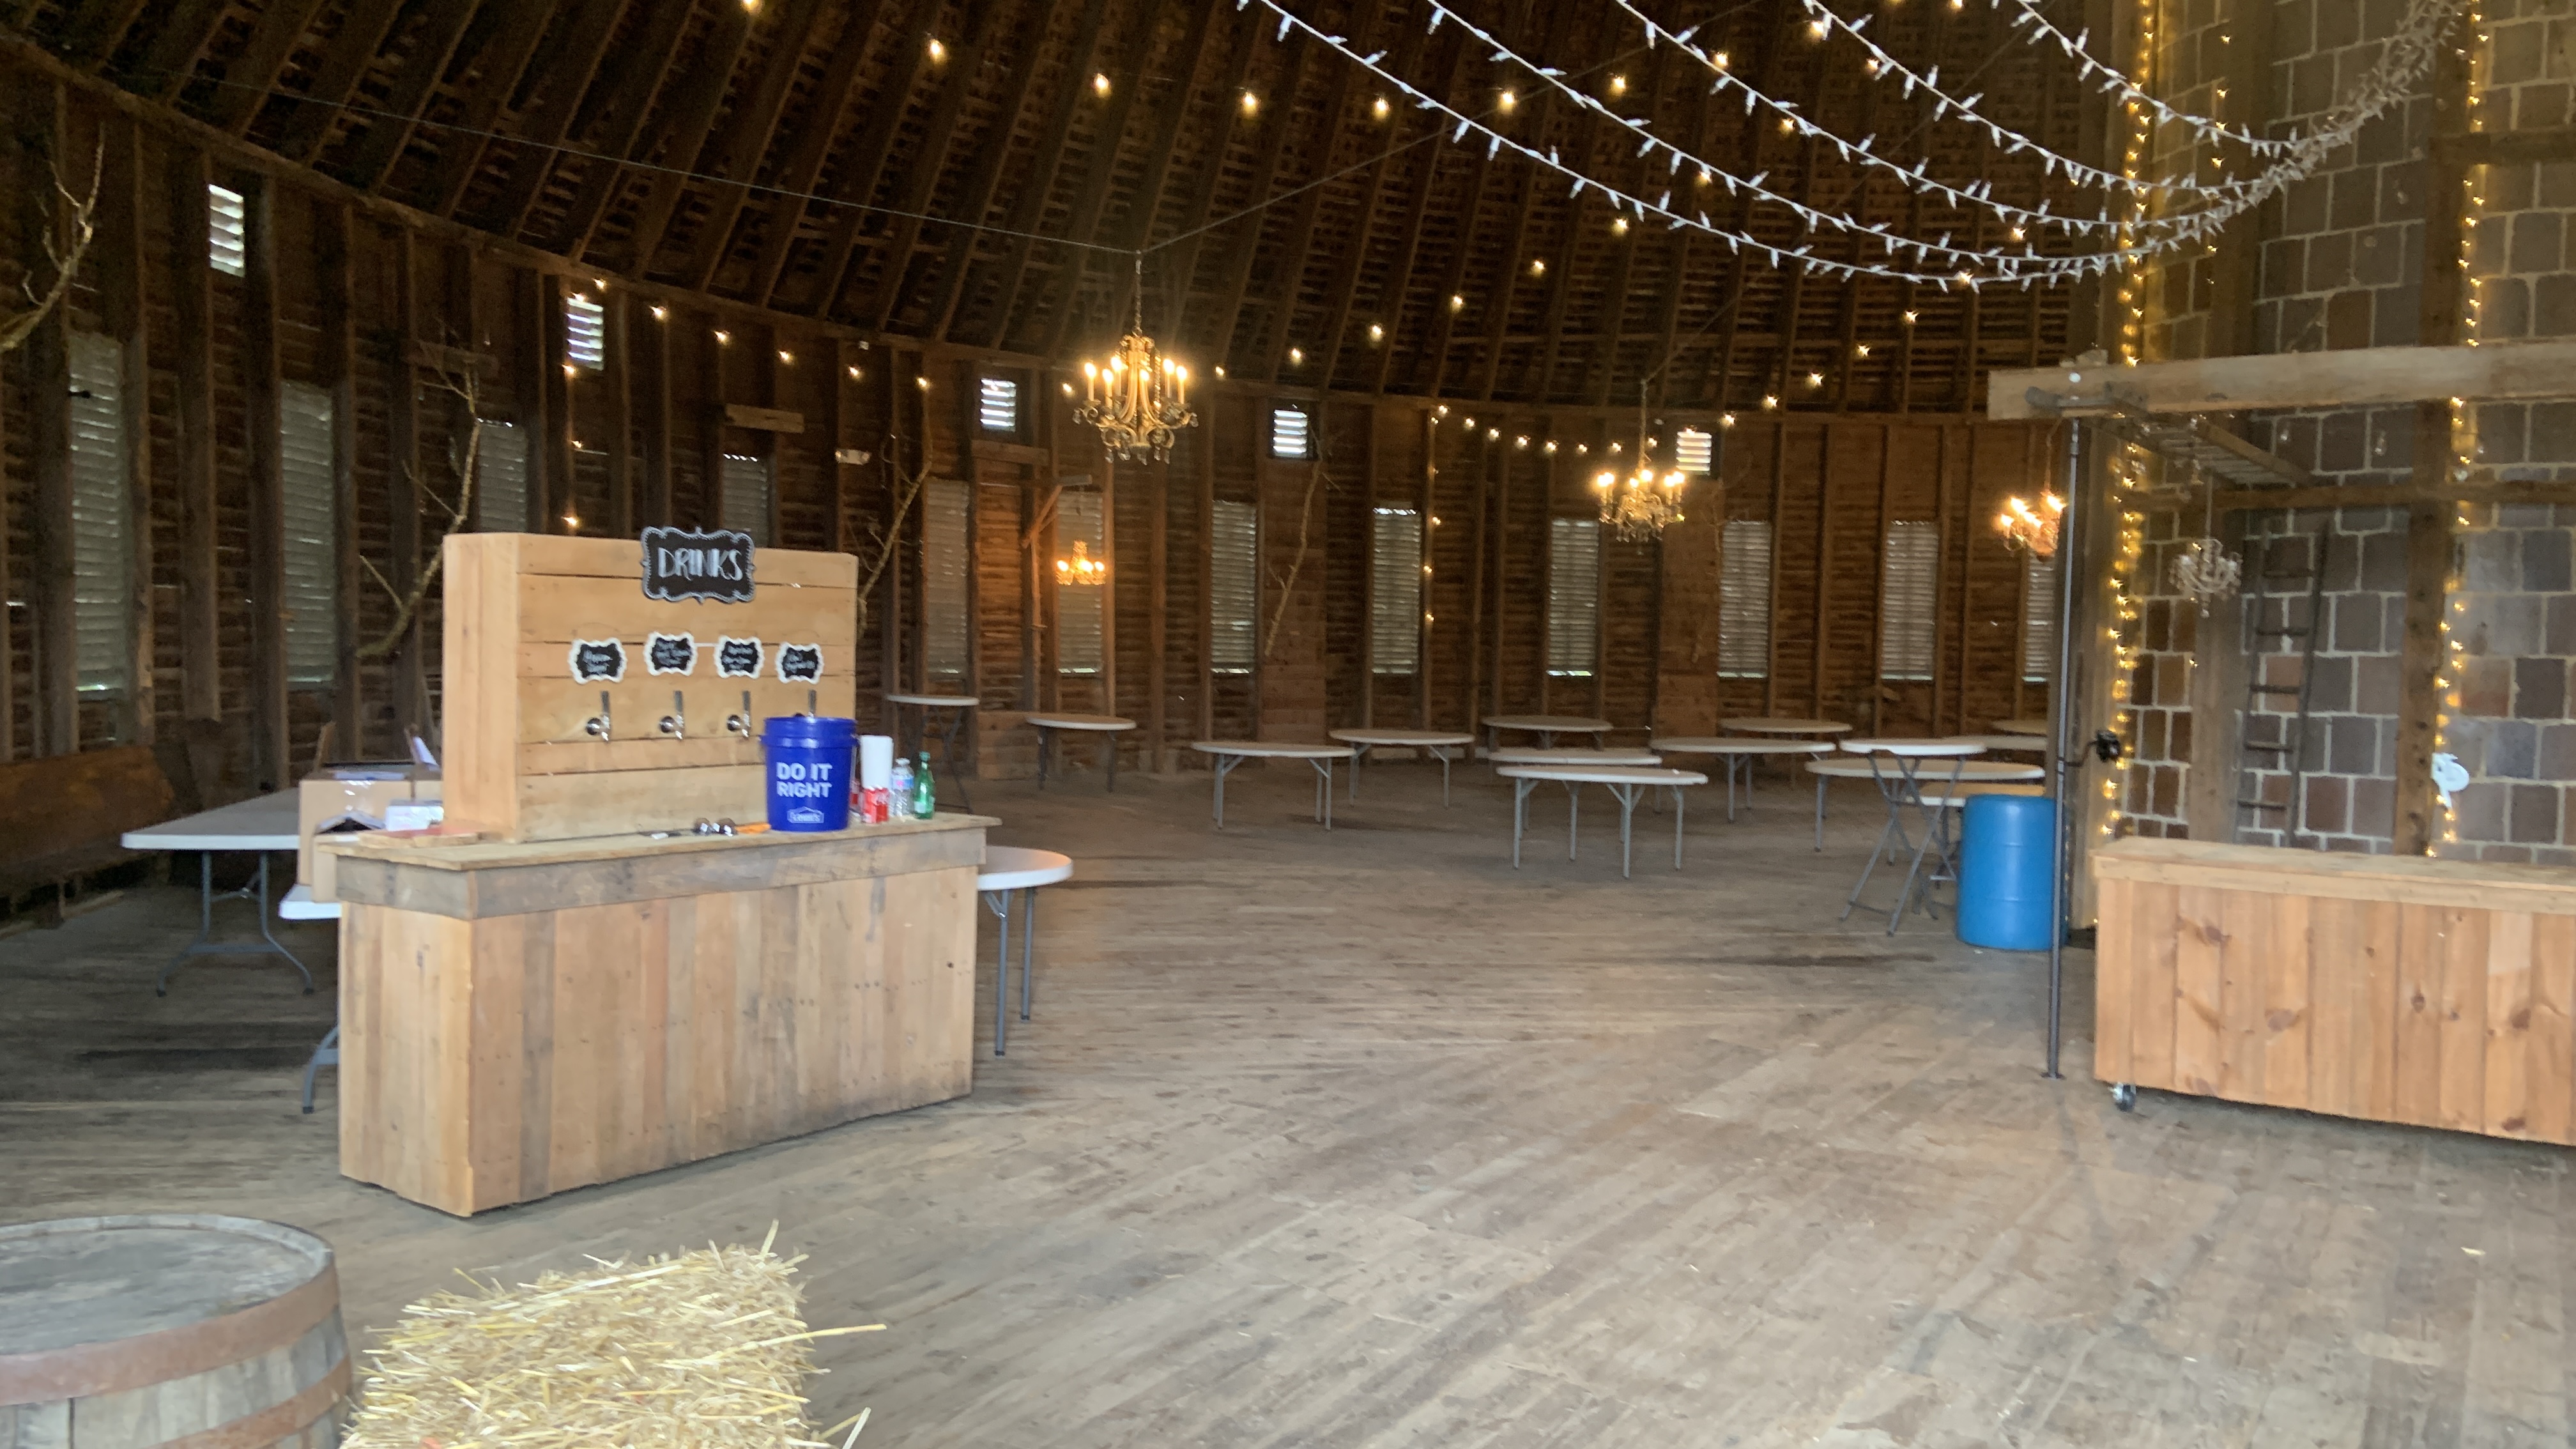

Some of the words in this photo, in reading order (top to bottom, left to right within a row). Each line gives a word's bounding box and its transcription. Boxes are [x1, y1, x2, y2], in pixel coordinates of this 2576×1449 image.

[658, 547, 744, 581] DRINKS
[776, 762, 806, 780] DO
[810, 763, 833, 781] IT
[776, 781, 832, 798] RIGHT
